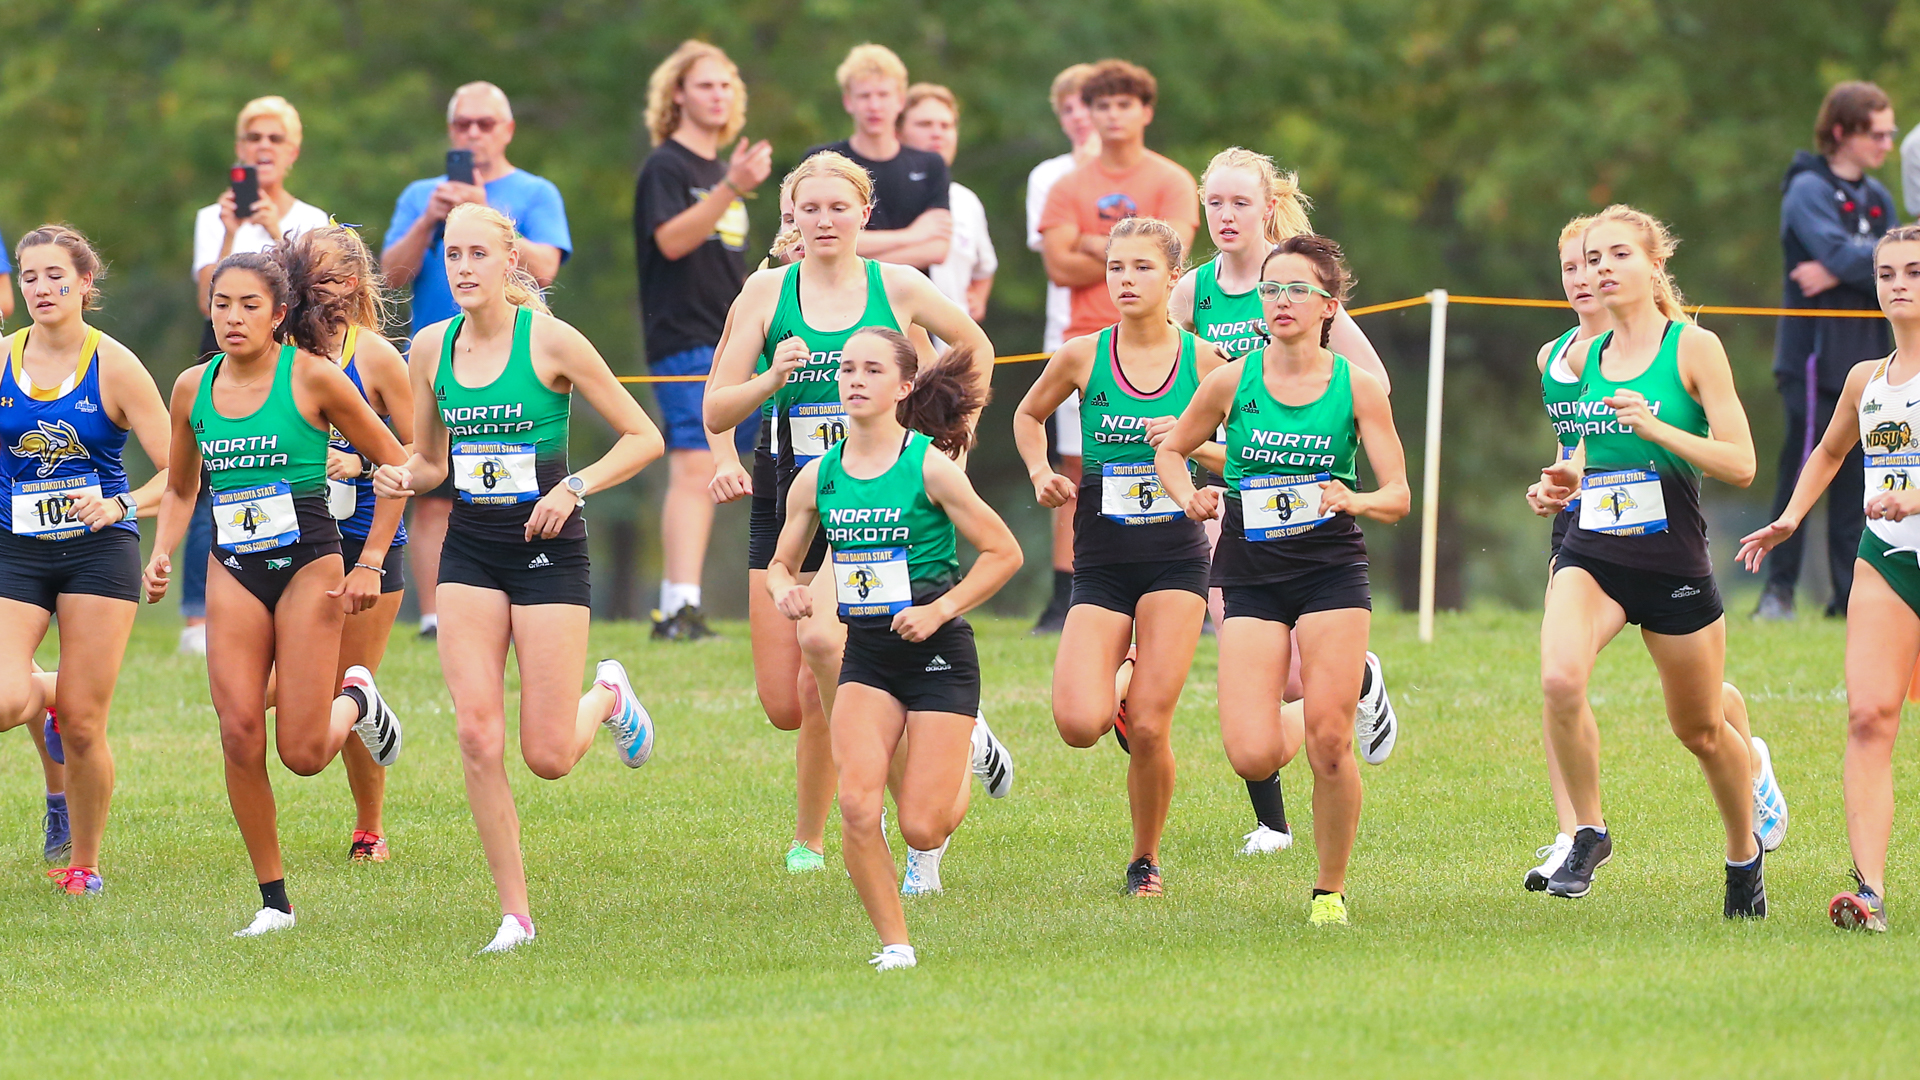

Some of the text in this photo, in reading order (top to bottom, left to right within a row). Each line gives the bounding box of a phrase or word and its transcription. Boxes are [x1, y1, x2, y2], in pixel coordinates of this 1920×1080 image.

[1207, 318, 1269, 339] NORTH
[1212, 335, 1272, 352] KOT
[786, 368, 841, 383] DAK
[442, 402, 523, 424] NORTH
[799, 405, 844, 415] SOUTH DAKOTA
[1577, 400, 1660, 419] NOH
[1100, 413, 1152, 432] NOR
[1577, 419, 1633, 437] DAKO
[200, 434, 278, 457] NORTH
[1094, 431, 1150, 444] DAK
[1250, 428, 1332, 450] NORTH
[1866, 431, 1899, 448] NDSU
[461, 444, 522, 453] SOUTH DAKOTA STATE
[1241, 446, 1336, 468] DAKOTA
[203, 453, 288, 471] DAKOTA
[1886, 456, 1907, 466] DAKOTA
[1908, 455, 1920, 465] STA
[482, 461, 496, 489] 8
[1113, 465, 1157, 475] SOUTH DAKOT
[22, 476, 87, 493] SOUTH DAKOTA STATE
[1250, 473, 1317, 488] SOUTH DAKOTA STATE
[1588, 471, 1647, 487] SOUTH DAKOTA STATE
[218, 485, 277, 504] SOUTH DAKOTA STATE
[471, 495, 518, 504] CROSS COUNTRY
[1139, 482, 1152, 510] 5
[35, 496, 77, 526] 102
[1276, 493, 1291, 521] 9
[244, 507, 257, 534] 4
[828, 508, 901, 526] NORTH
[1125, 514, 1174, 525] CROSS COUNTRY
[56, 528, 85, 541] COUNTRY
[826, 527, 910, 541] DAKOTA
[1265, 524, 1315, 539] CROSS COUNTRY
[1616, 526, 1645, 536] COUNTRY
[235, 538, 279, 554] CROSS COUNTRY
[836, 550, 892, 562] SOUTH DAKOTA STATE
[856, 570, 869, 599] 3
[1671, 589, 1701, 599] adidas
[848, 605, 890, 615] CROSS COUNTRY
[925, 664, 951, 672] adidas
